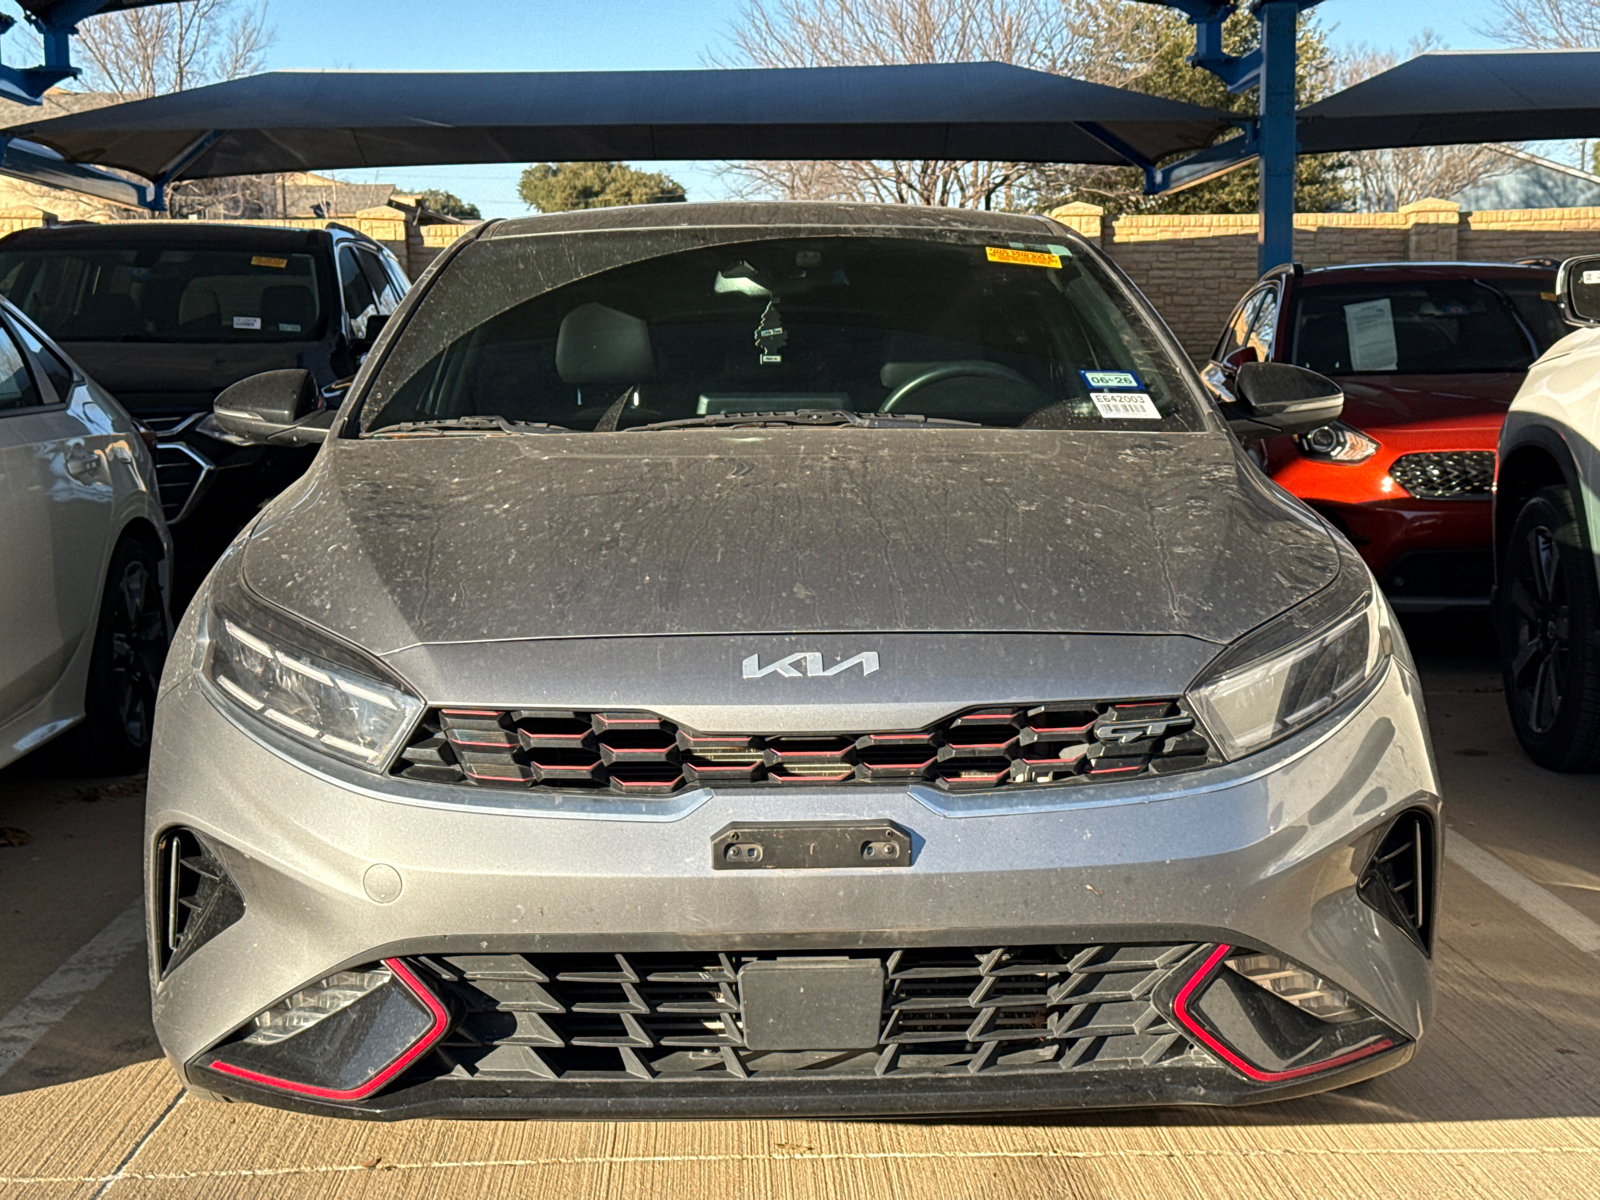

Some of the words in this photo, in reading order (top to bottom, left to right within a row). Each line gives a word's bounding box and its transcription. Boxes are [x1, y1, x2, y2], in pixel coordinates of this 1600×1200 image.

[1094, 395, 1146, 404] E642003
[742, 651, 880, 678] KIA
[1095, 719, 1193, 743] GT
